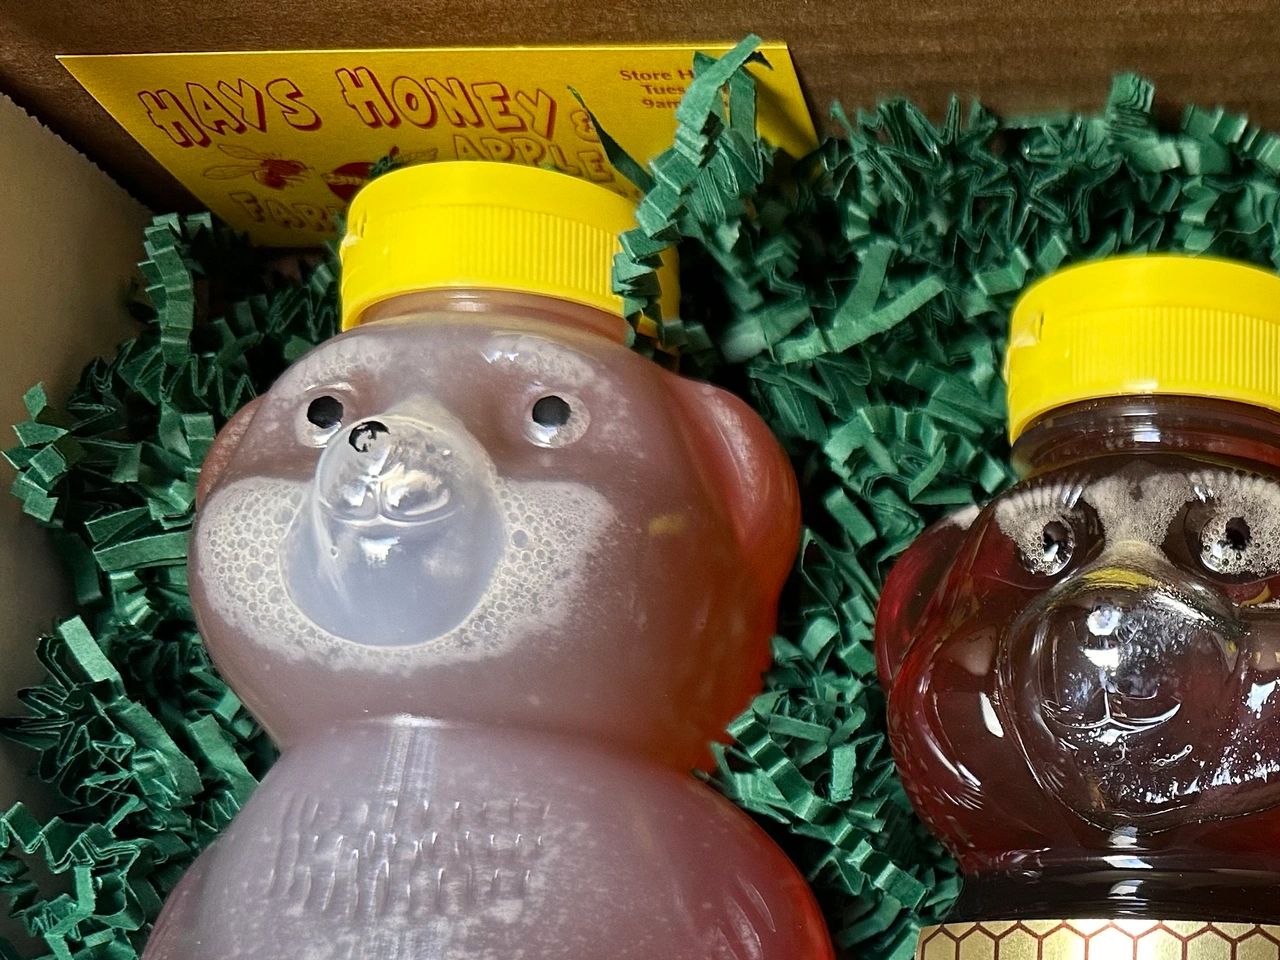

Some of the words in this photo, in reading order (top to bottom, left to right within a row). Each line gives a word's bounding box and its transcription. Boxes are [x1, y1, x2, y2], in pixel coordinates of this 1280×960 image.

[620, 69, 672, 81] Store
[138, 78, 322, 148] HAYS
[335, 66, 558, 142] HONEY
[454, 134, 615, 183] APPLE
